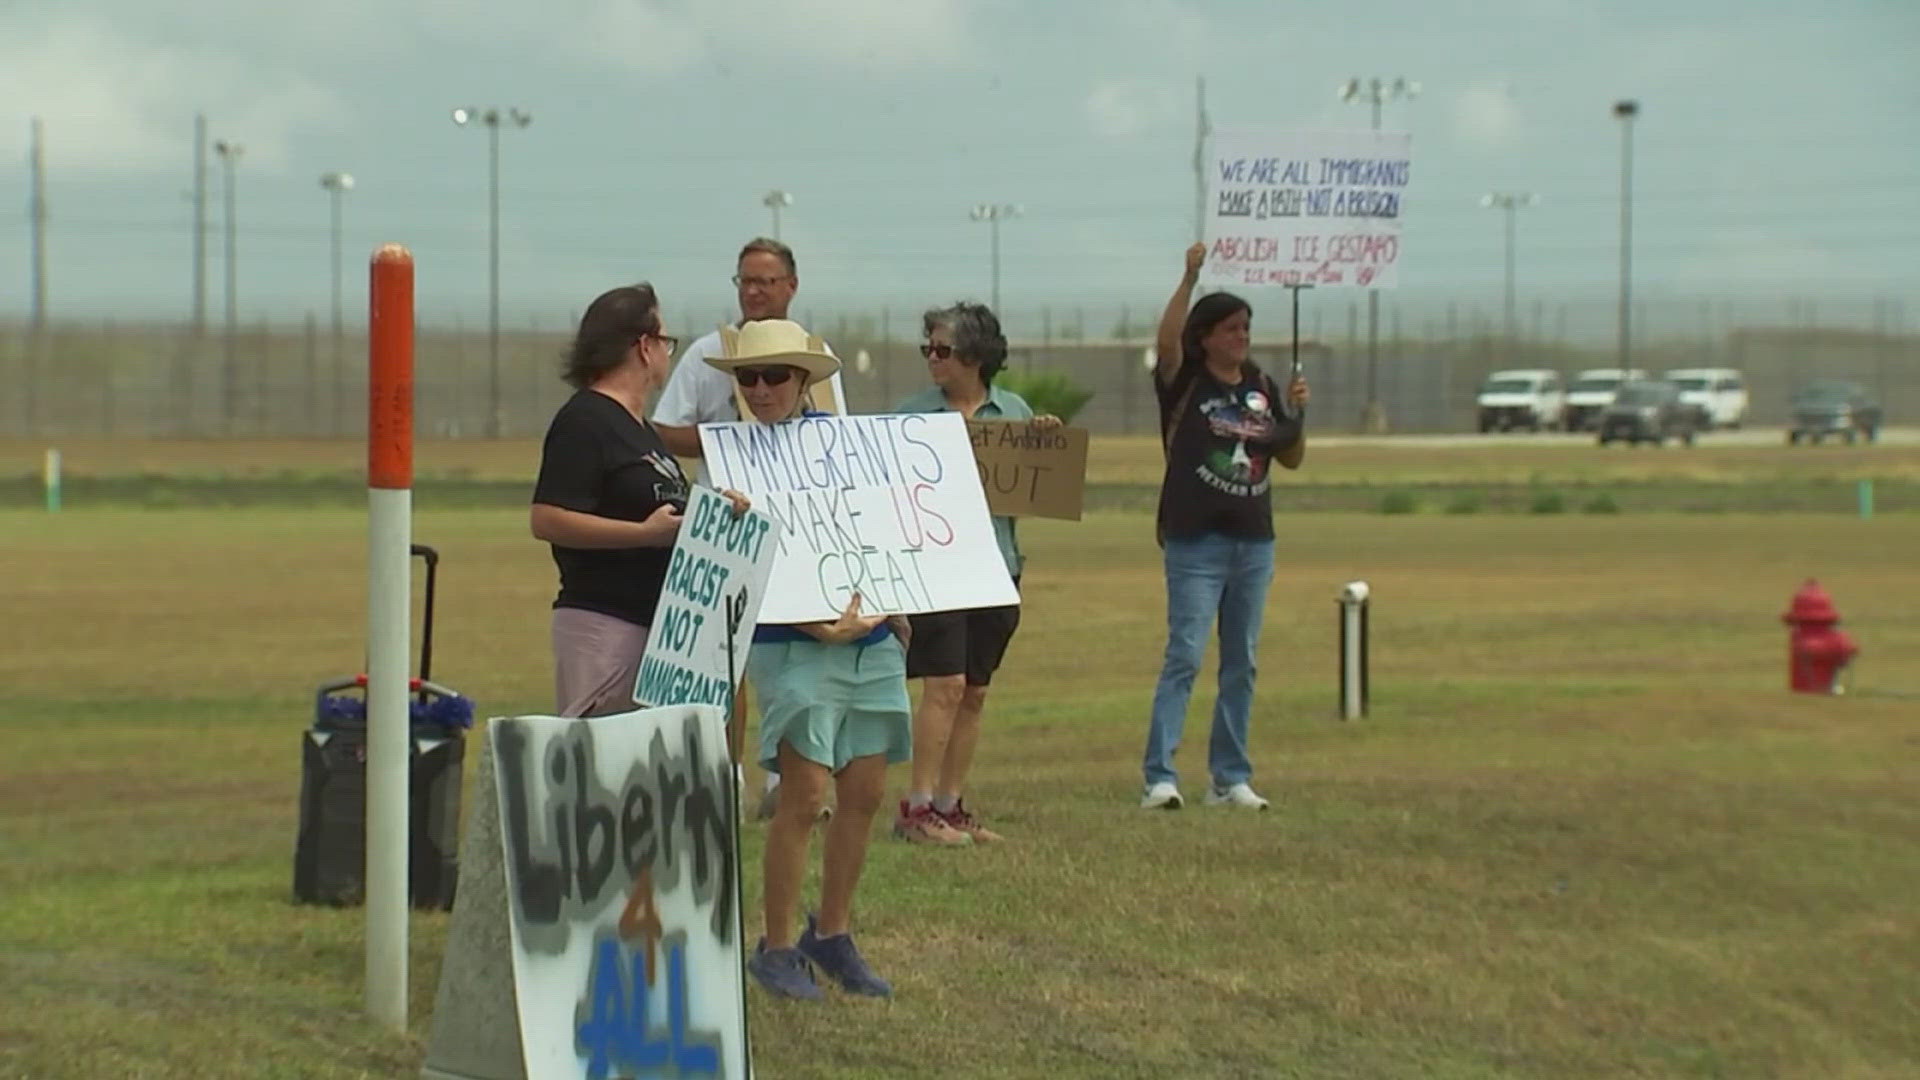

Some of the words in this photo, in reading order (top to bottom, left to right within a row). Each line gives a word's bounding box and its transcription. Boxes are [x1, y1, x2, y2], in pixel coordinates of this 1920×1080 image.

[1218, 189, 1251, 216] MAKE
[1220, 160, 1246, 183] WE
[1249, 158, 1279, 184] ARE
[1281, 161, 1309, 184] ALL
[1319, 158, 1410, 186] IMMIGRANTS
[1210, 237, 1278, 262] ABOLISH
[1292, 235, 1320, 263] ICE
[1327, 234, 1398, 264] GESTAPO
[707, 415, 943, 494] IMMIGRANTS
[690, 494, 769, 563] DEPORT
[765, 486, 877, 556] MAKE
[890, 483, 954, 549] US
[666, 548, 729, 611] RACIST
[817, 548, 934, 615] GREAT
[657, 604, 704, 657] NOT
[500, 716, 736, 944] Liberty
[619, 862, 662, 986] 4
[577, 935, 722, 1078] ALL
